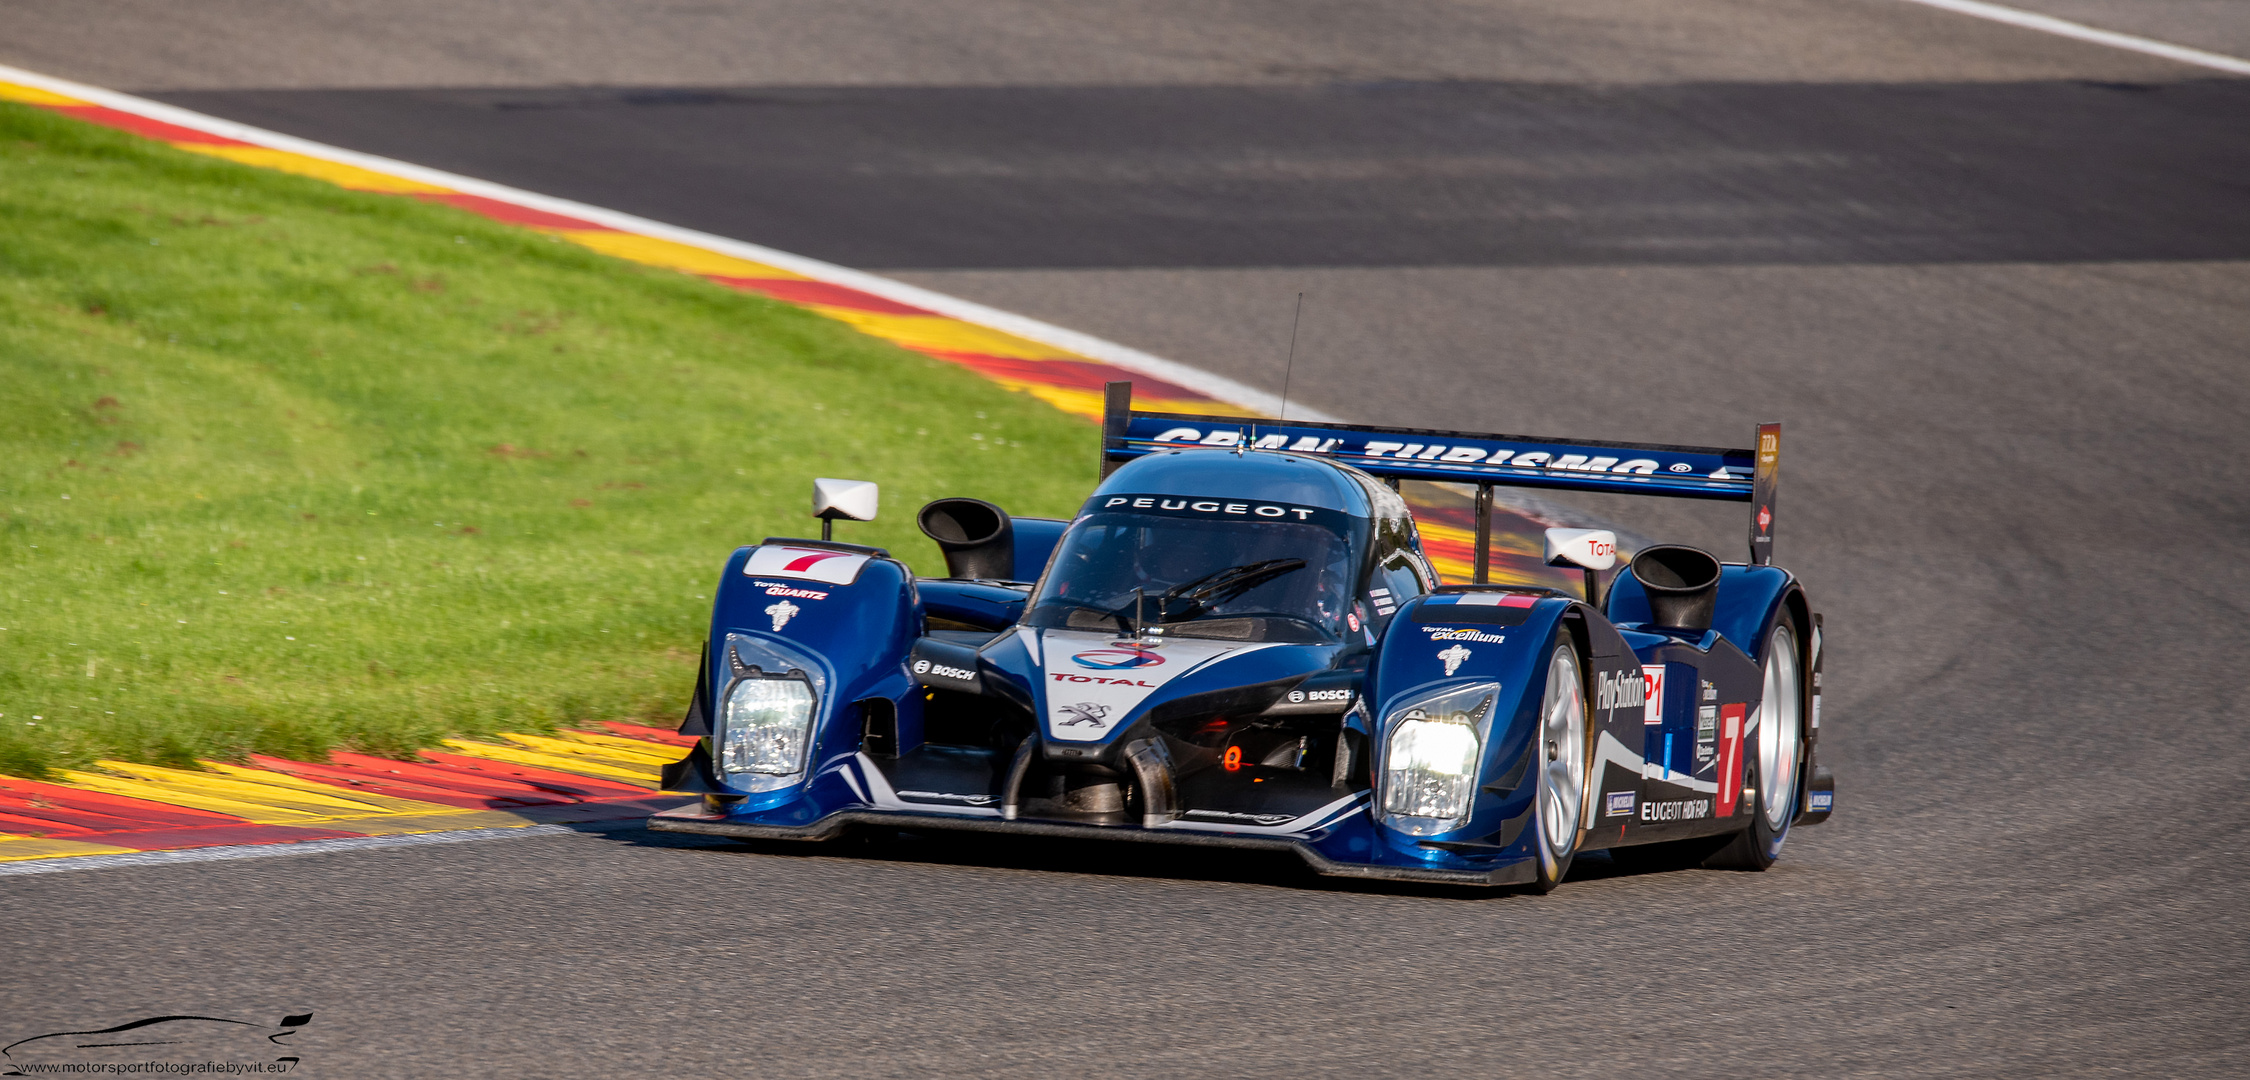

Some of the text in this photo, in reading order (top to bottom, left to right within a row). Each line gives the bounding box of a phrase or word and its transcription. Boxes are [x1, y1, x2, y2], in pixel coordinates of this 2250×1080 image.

[1105, 497, 1314, 520] PEUGEOT
[1588, 540, 1616, 556] TOTA
[781, 546, 853, 573] 7
[753, 580, 790, 589] TOTAL
[765, 587, 829, 600] QUARTZ
[1430, 630, 1505, 644] excellium
[931, 663, 976, 680] BOSCH
[1049, 672, 1156, 688] TOTAL
[1308, 689, 1355, 701] BOSCH
[1596, 668, 1644, 723] PlayStation
[1724, 716, 1740, 804] 7
[1641, 801, 1682, 821] EUGEOT
